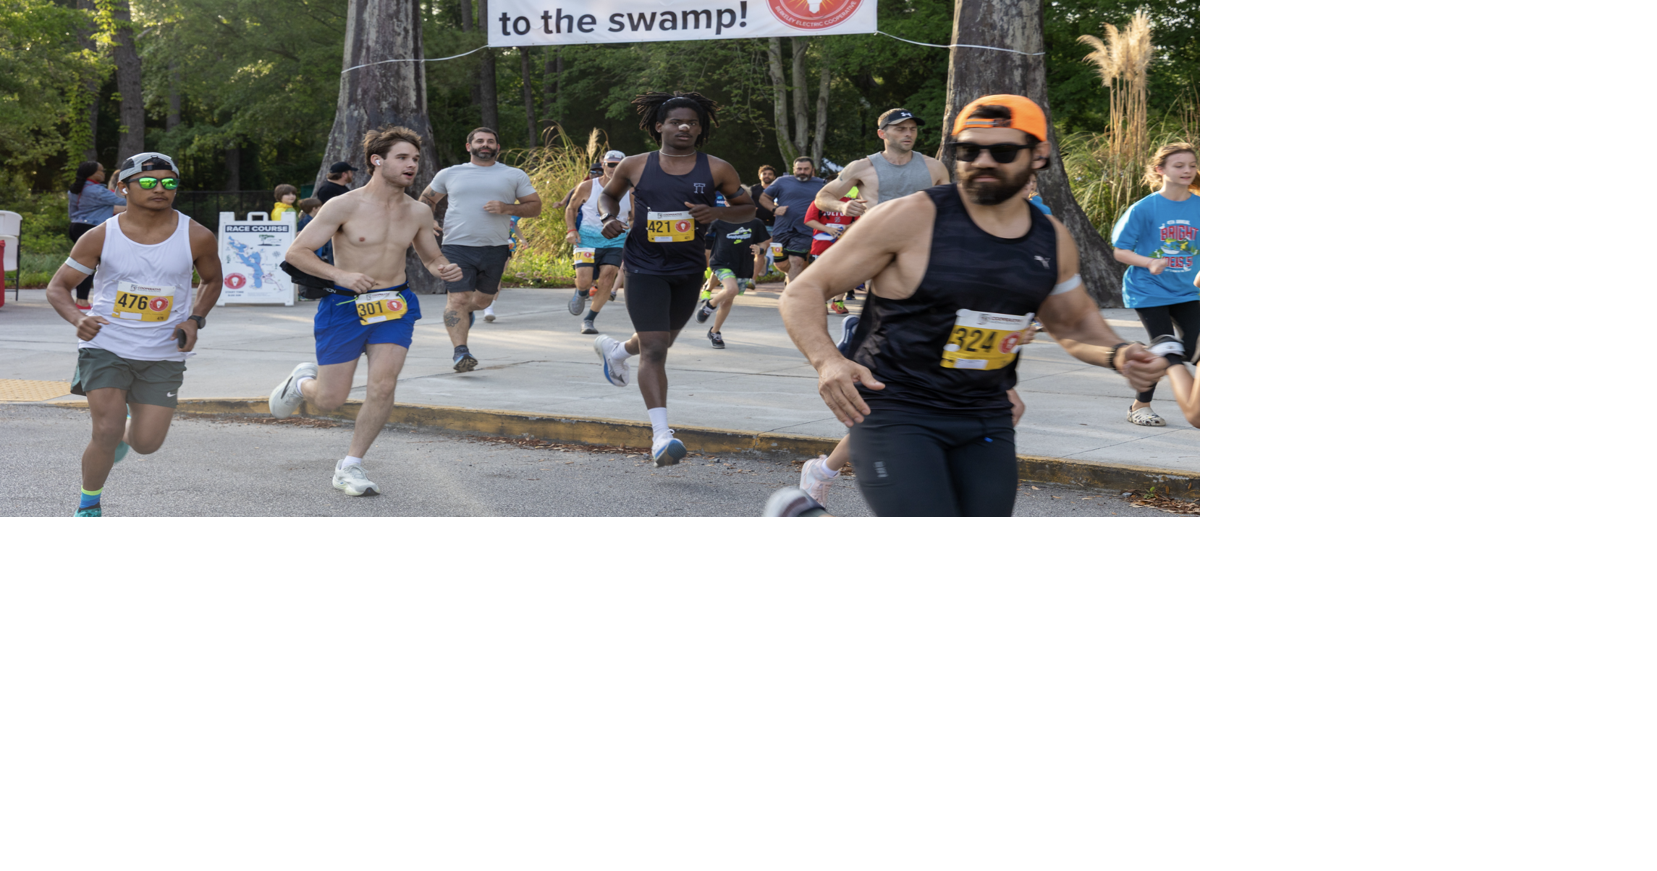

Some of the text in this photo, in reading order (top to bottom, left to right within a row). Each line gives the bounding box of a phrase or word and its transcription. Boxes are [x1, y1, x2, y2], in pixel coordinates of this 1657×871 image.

[499, 1, 747, 36] to the swamp!
[775, 5, 795, 23] BERKELEY
[824, 1, 857, 25] COOPERATIVE
[648, 221, 670, 233] 421
[1160, 225, 1199, 241] BRIGHT
[118, 293, 148, 310] 476
[357, 301, 383, 317] 301
[952, 327, 998, 353] 324
